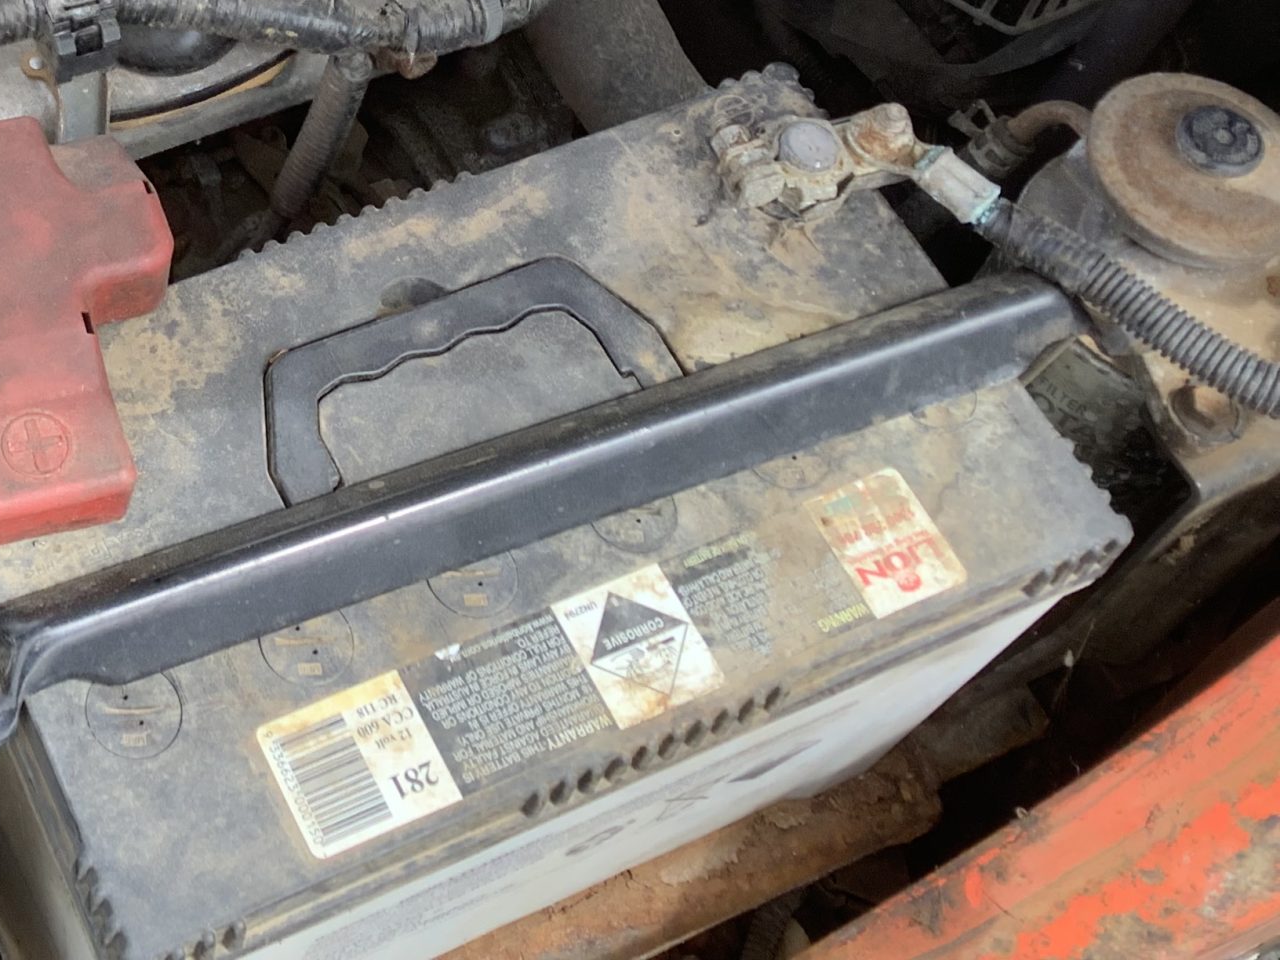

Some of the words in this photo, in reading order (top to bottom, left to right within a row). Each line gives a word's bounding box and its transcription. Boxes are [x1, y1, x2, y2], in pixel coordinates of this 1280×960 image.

[1035, 375, 1088, 416] FILTER
[853, 536, 944, 587] LION
[528, 623, 561, 643] REFER
[544, 632, 566, 648] FOR
[599, 614, 666, 651] CORROSIVE
[524, 639, 549, 657] FULL
[539, 646, 561, 663] ANY
[556, 642, 572, 655] BY
[474, 648, 528, 678] CONDITIONS
[516, 654, 543, 672] LAWS
[461, 668, 479, 683] OF
[477, 667, 510, 688] FORCE
[564, 672, 588, 689] THIS
[415, 674, 466, 702] WARRANTY
[479, 675, 522, 700] IMPOSED
[508, 684, 530, 700] ANY
[516, 680, 568, 709] WARRANTY
[526, 679, 542, 693] TO
[375, 692, 399, 710] RC
[455, 692, 512, 723] CONDITIONS
[464, 691, 483, 706] OR
[540, 687, 581, 711] MONTHS
[354, 701, 377, 719] 118
[379, 704, 416, 729] CCA
[429, 698, 468, 721] IMPLIED
[488, 701, 521, 721] OFFER
[354, 718, 382, 740] 600
[440, 715, 458, 730] OR
[483, 719, 505, 736] USE
[513, 718, 536, 735] AND
[543, 711, 613, 752] WARRANTY
[372, 732, 399, 752] volt
[396, 726, 413, 742] 12
[470, 726, 517, 754] MATERIAL
[496, 729, 542, 756] AGAINST
[451, 745, 474, 762] FOR
[459, 747, 500, 772] FAULTY
[470, 750, 522, 780] BATTERY
[387, 759, 443, 801] 281
[460, 769, 476, 784] IS
